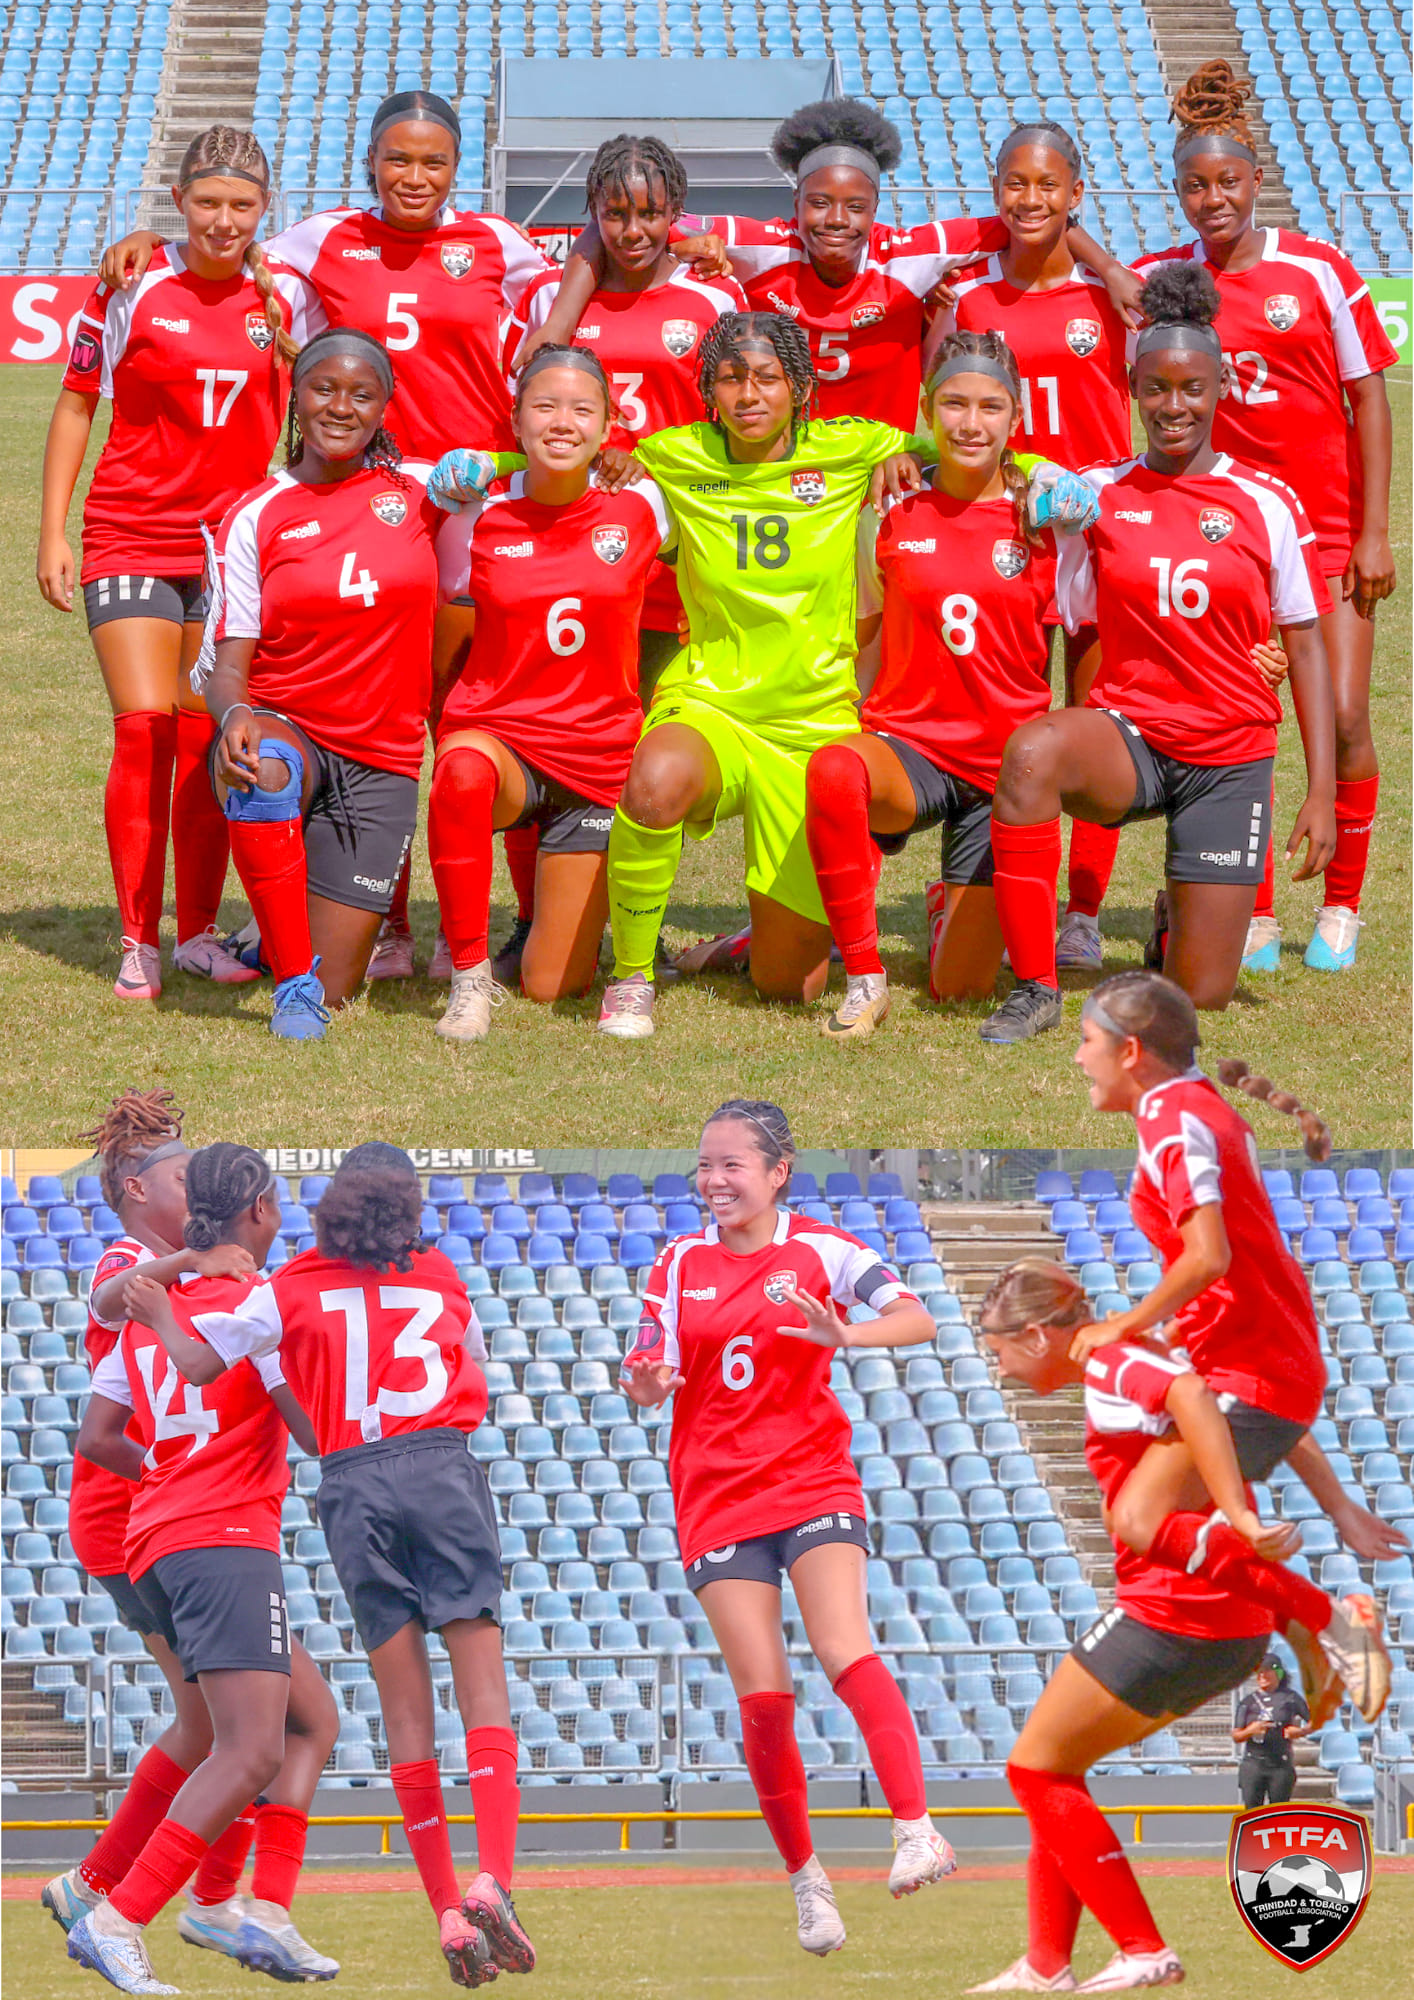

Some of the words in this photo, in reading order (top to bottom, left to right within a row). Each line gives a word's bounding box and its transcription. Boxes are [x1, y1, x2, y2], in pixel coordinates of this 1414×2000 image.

[767, 291, 800, 319] capelli
[856, 307, 881, 316] TTFA
[151, 317, 189, 332] capelli
[385, 292, 420, 351] 5
[196, 368, 249, 427] 17
[612, 372, 647, 431] 3
[795, 473, 820, 481] TTFA
[688, 480, 729, 494] capelli
[1114, 510, 1153, 524] capelli
[1206, 511, 1231, 521] TTFA
[280, 520, 320, 539] capelli
[597, 530, 622, 538] TTFA
[494, 541, 533, 557] capelli
[730, 514, 791, 570] 18
[898, 538, 936, 552] capelli
[339, 552, 379, 607] 4
[1149, 556, 1210, 619] 16
[547, 597, 586, 656] 6
[941, 593, 978, 656] 8
[1199, 850, 1241, 865] capelli
[682, 1286, 717, 1300] capelli
[319, 1285, 449, 1421] 13
[722, 1335, 755, 1391] 6
[797, 1516, 833, 1537] capelli
[408, 1816, 439, 1831] capelli
